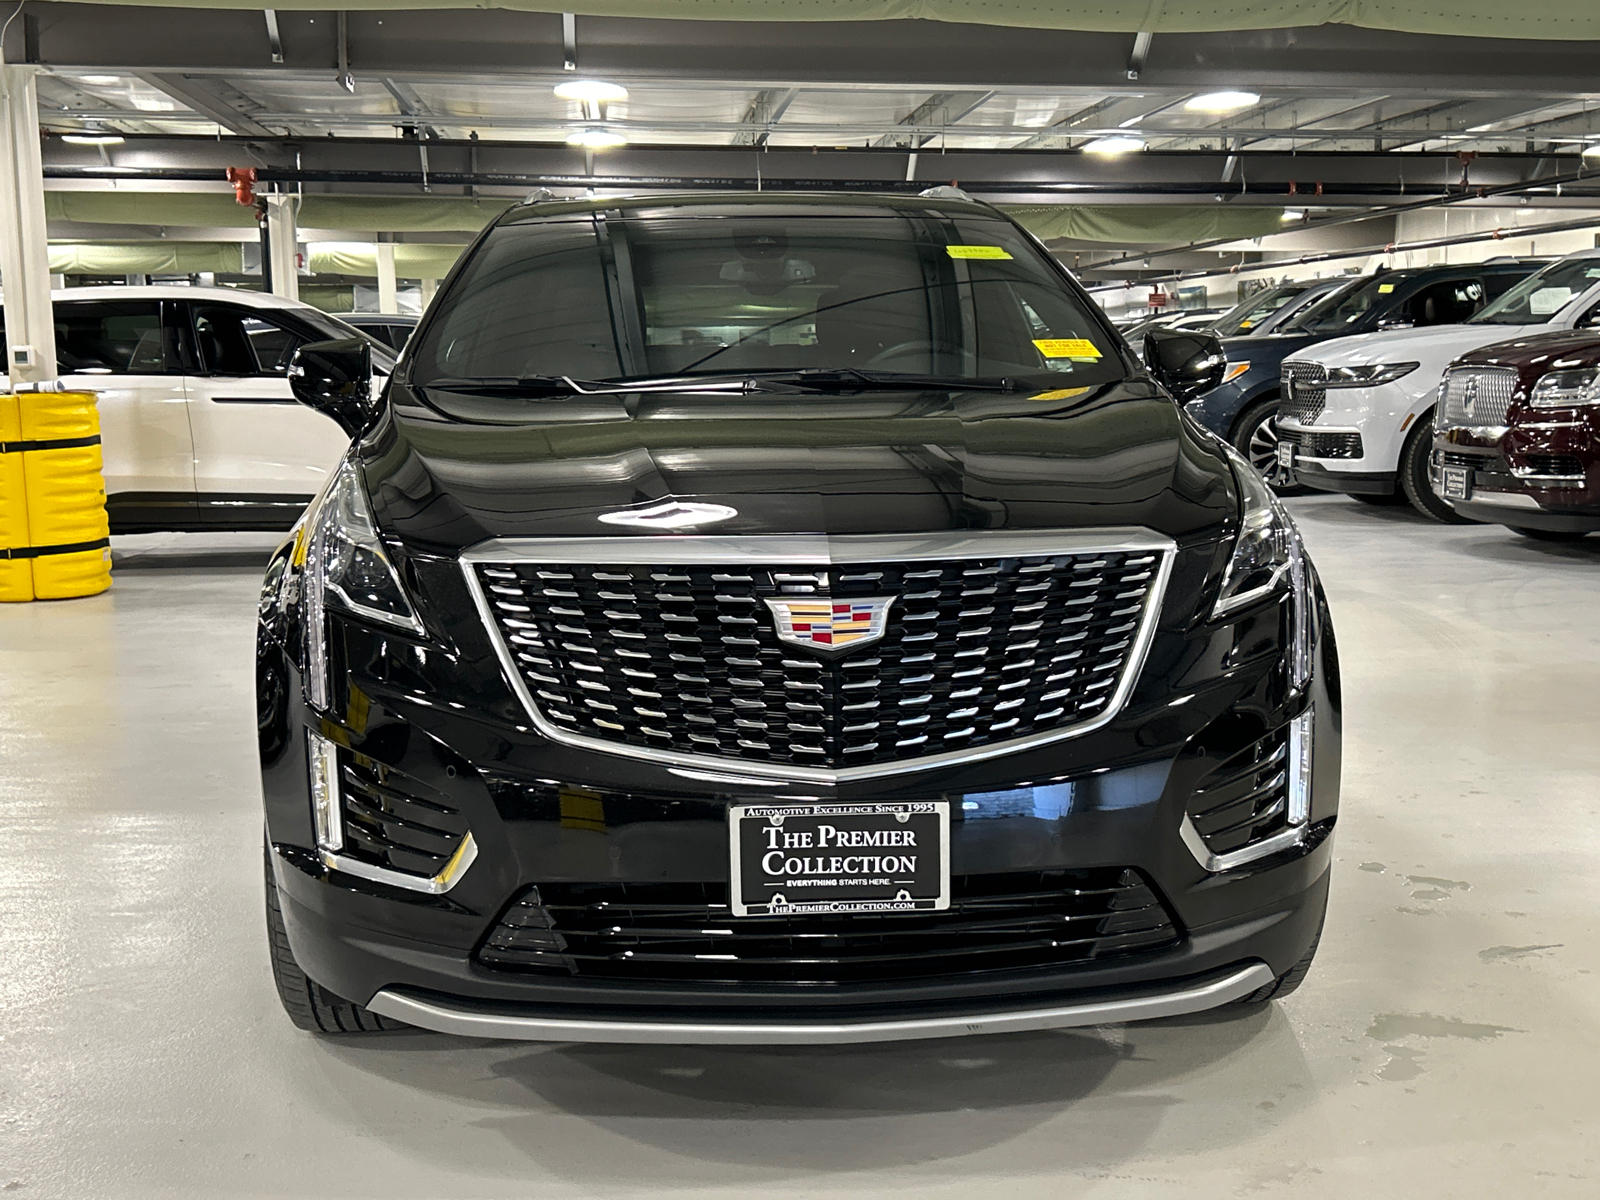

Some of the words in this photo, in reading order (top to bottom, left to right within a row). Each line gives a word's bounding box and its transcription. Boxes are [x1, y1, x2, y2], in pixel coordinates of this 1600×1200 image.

[746, 808, 811, 816] AUTOMOTIVE
[813, 806, 873, 814] EXCELLENCE
[875, 804, 905, 813] SINCE
[907, 803, 934, 812] 1995
[762, 826, 814, 849] THE
[817, 825, 917, 847] PREMIER
[762, 851, 917, 875] COLLECTION
[786, 878, 838, 887] EVERYTHING
[839, 878, 868, 886] STARTS
